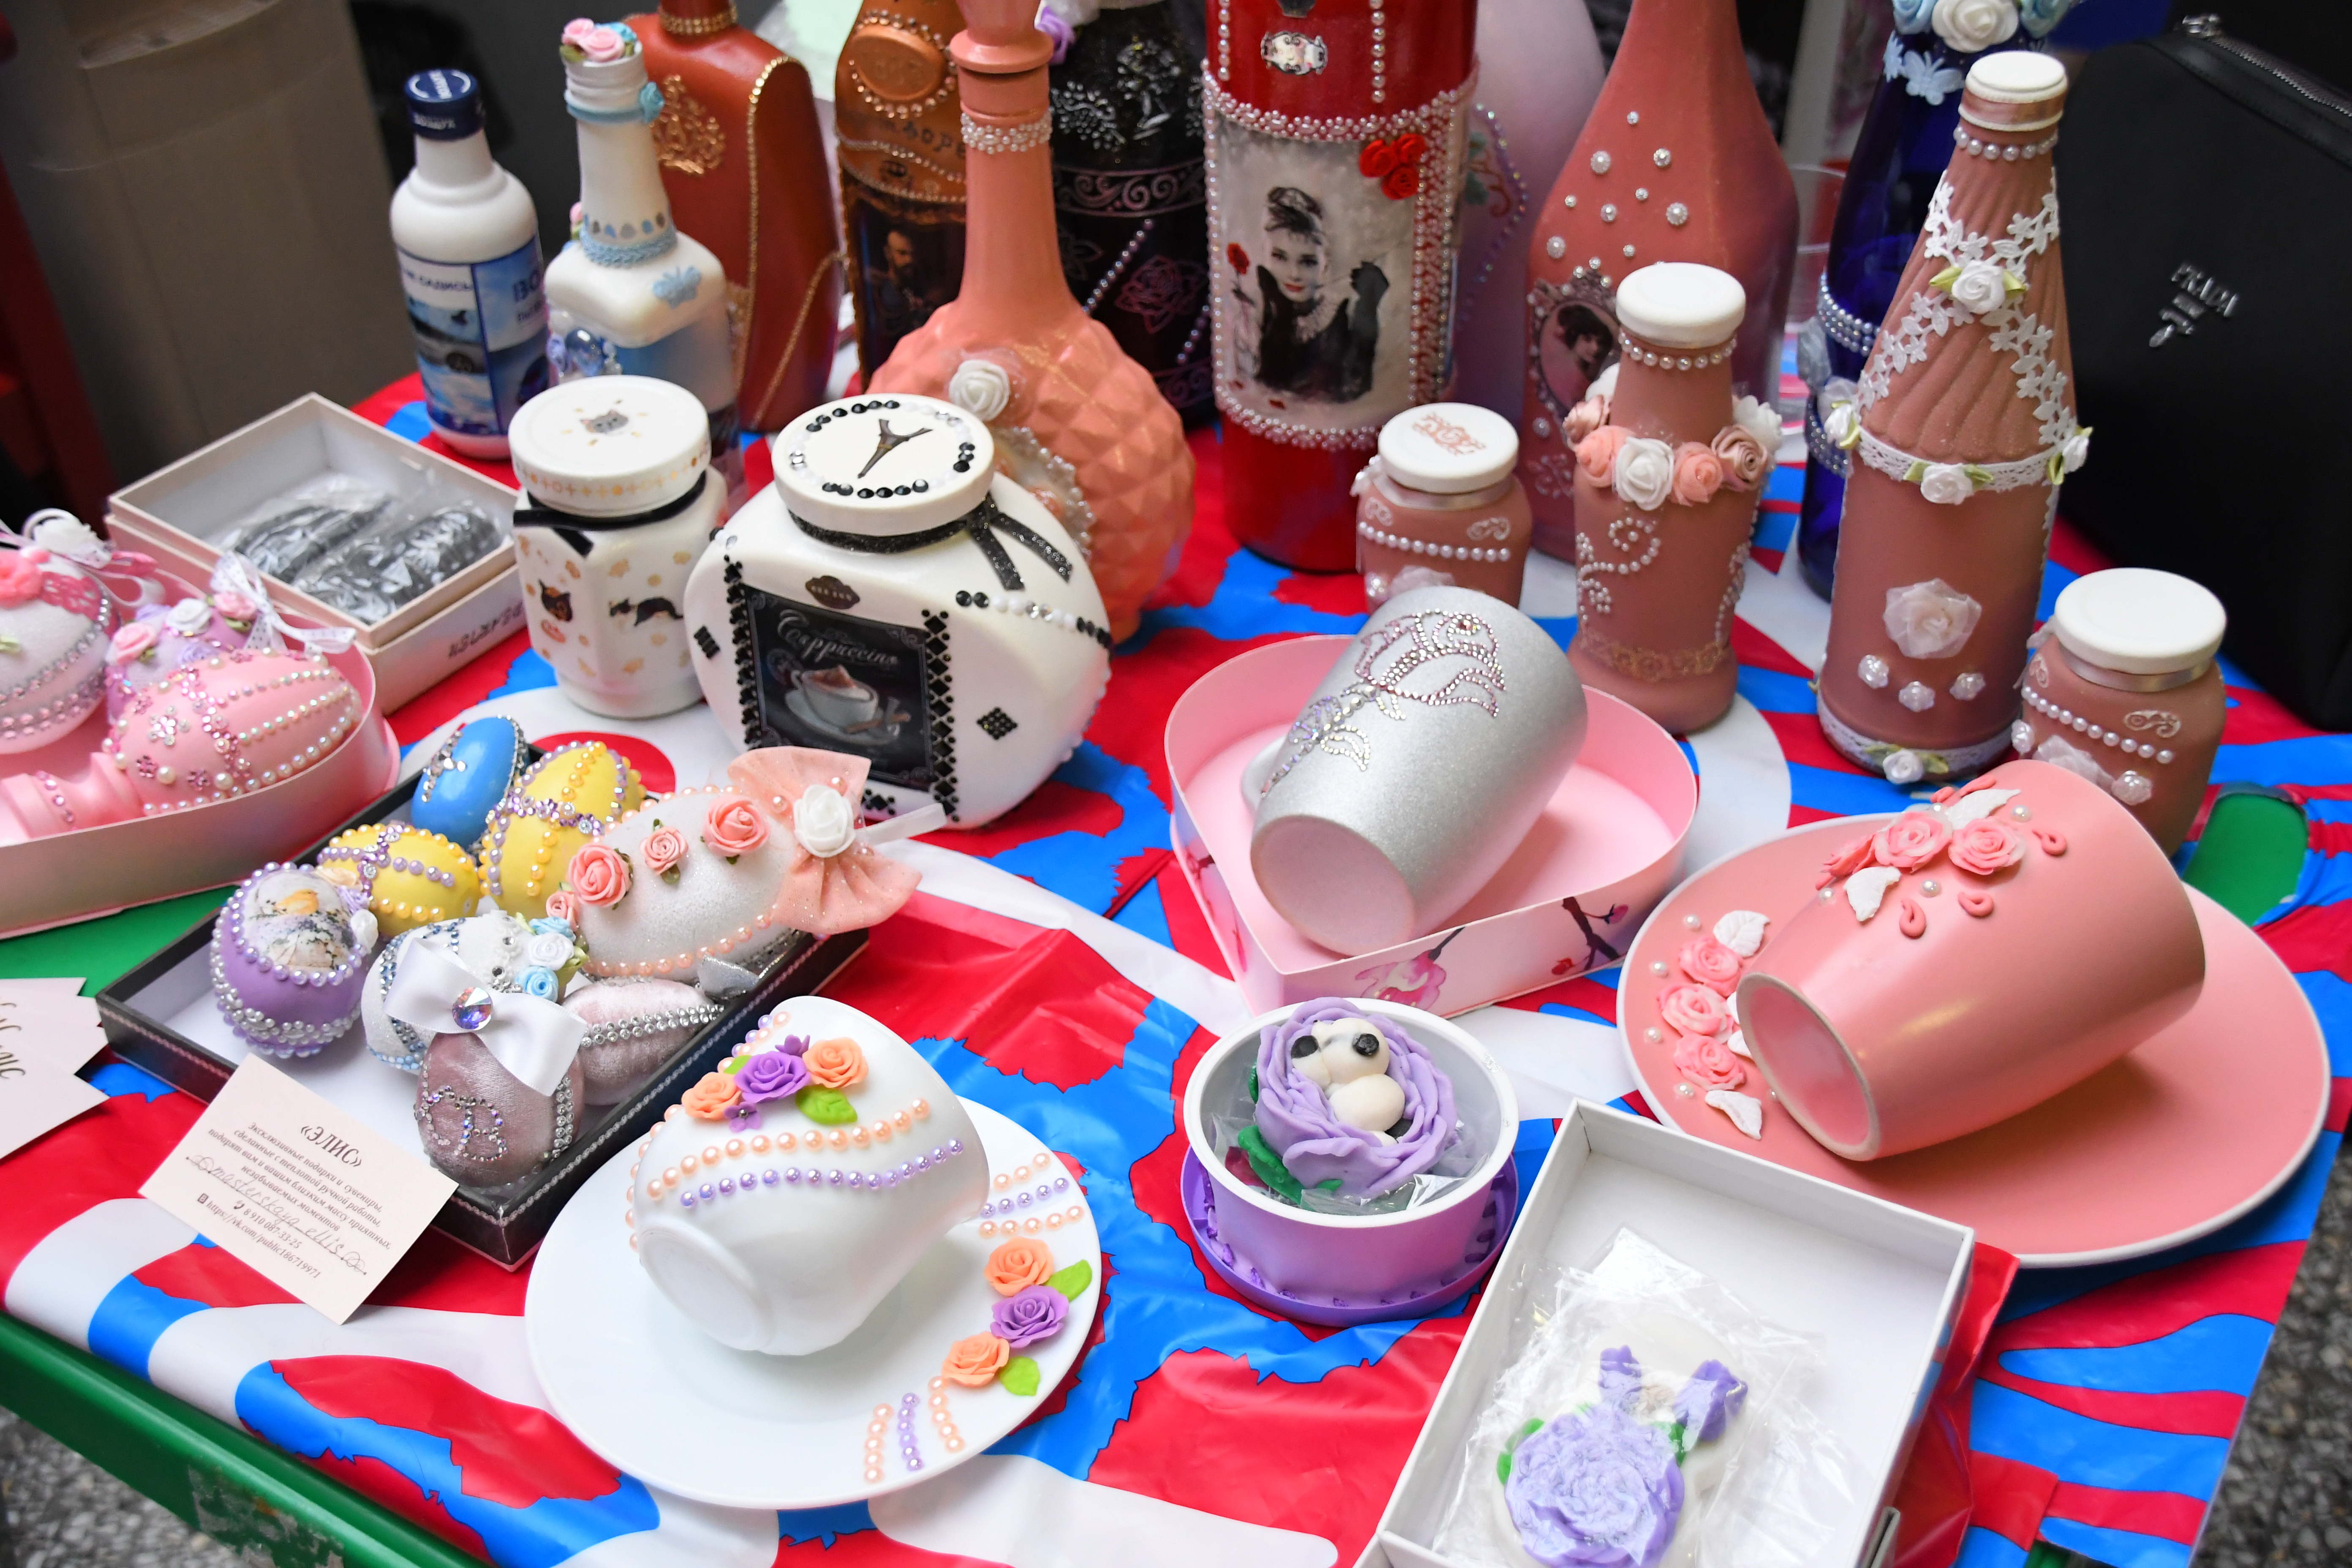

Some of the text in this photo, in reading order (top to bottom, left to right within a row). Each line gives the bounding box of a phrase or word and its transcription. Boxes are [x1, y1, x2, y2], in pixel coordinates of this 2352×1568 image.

[234, 1130, 275, 1158] сделанные
[279, 1159, 322, 1187] теплотой
[318, 1185, 350, 1205] ручной
[345, 1203, 381, 1228] работы,
[248, 1122, 305, 1161] Эксклюзивные
[303, 1159, 337, 1182] подарки
[344, 1185, 382, 1213] сувениры,
[300, 1126, 362, 1168] «ЭЛИС»
[208, 1129, 242, 1153] подарят
[242, 1151, 259, 1163] вам
[264, 1165, 292, 1185] вашим
[291, 1181, 326, 1206] близким
[324, 1205, 350, 1222] массу
[348, 1219, 391, 1250] приятных,
[241, 1166, 340, 1232] незабываемых моментов
[249, 1213, 266, 1225] 910
[264, 1222, 302, 1249] 087-33-25
